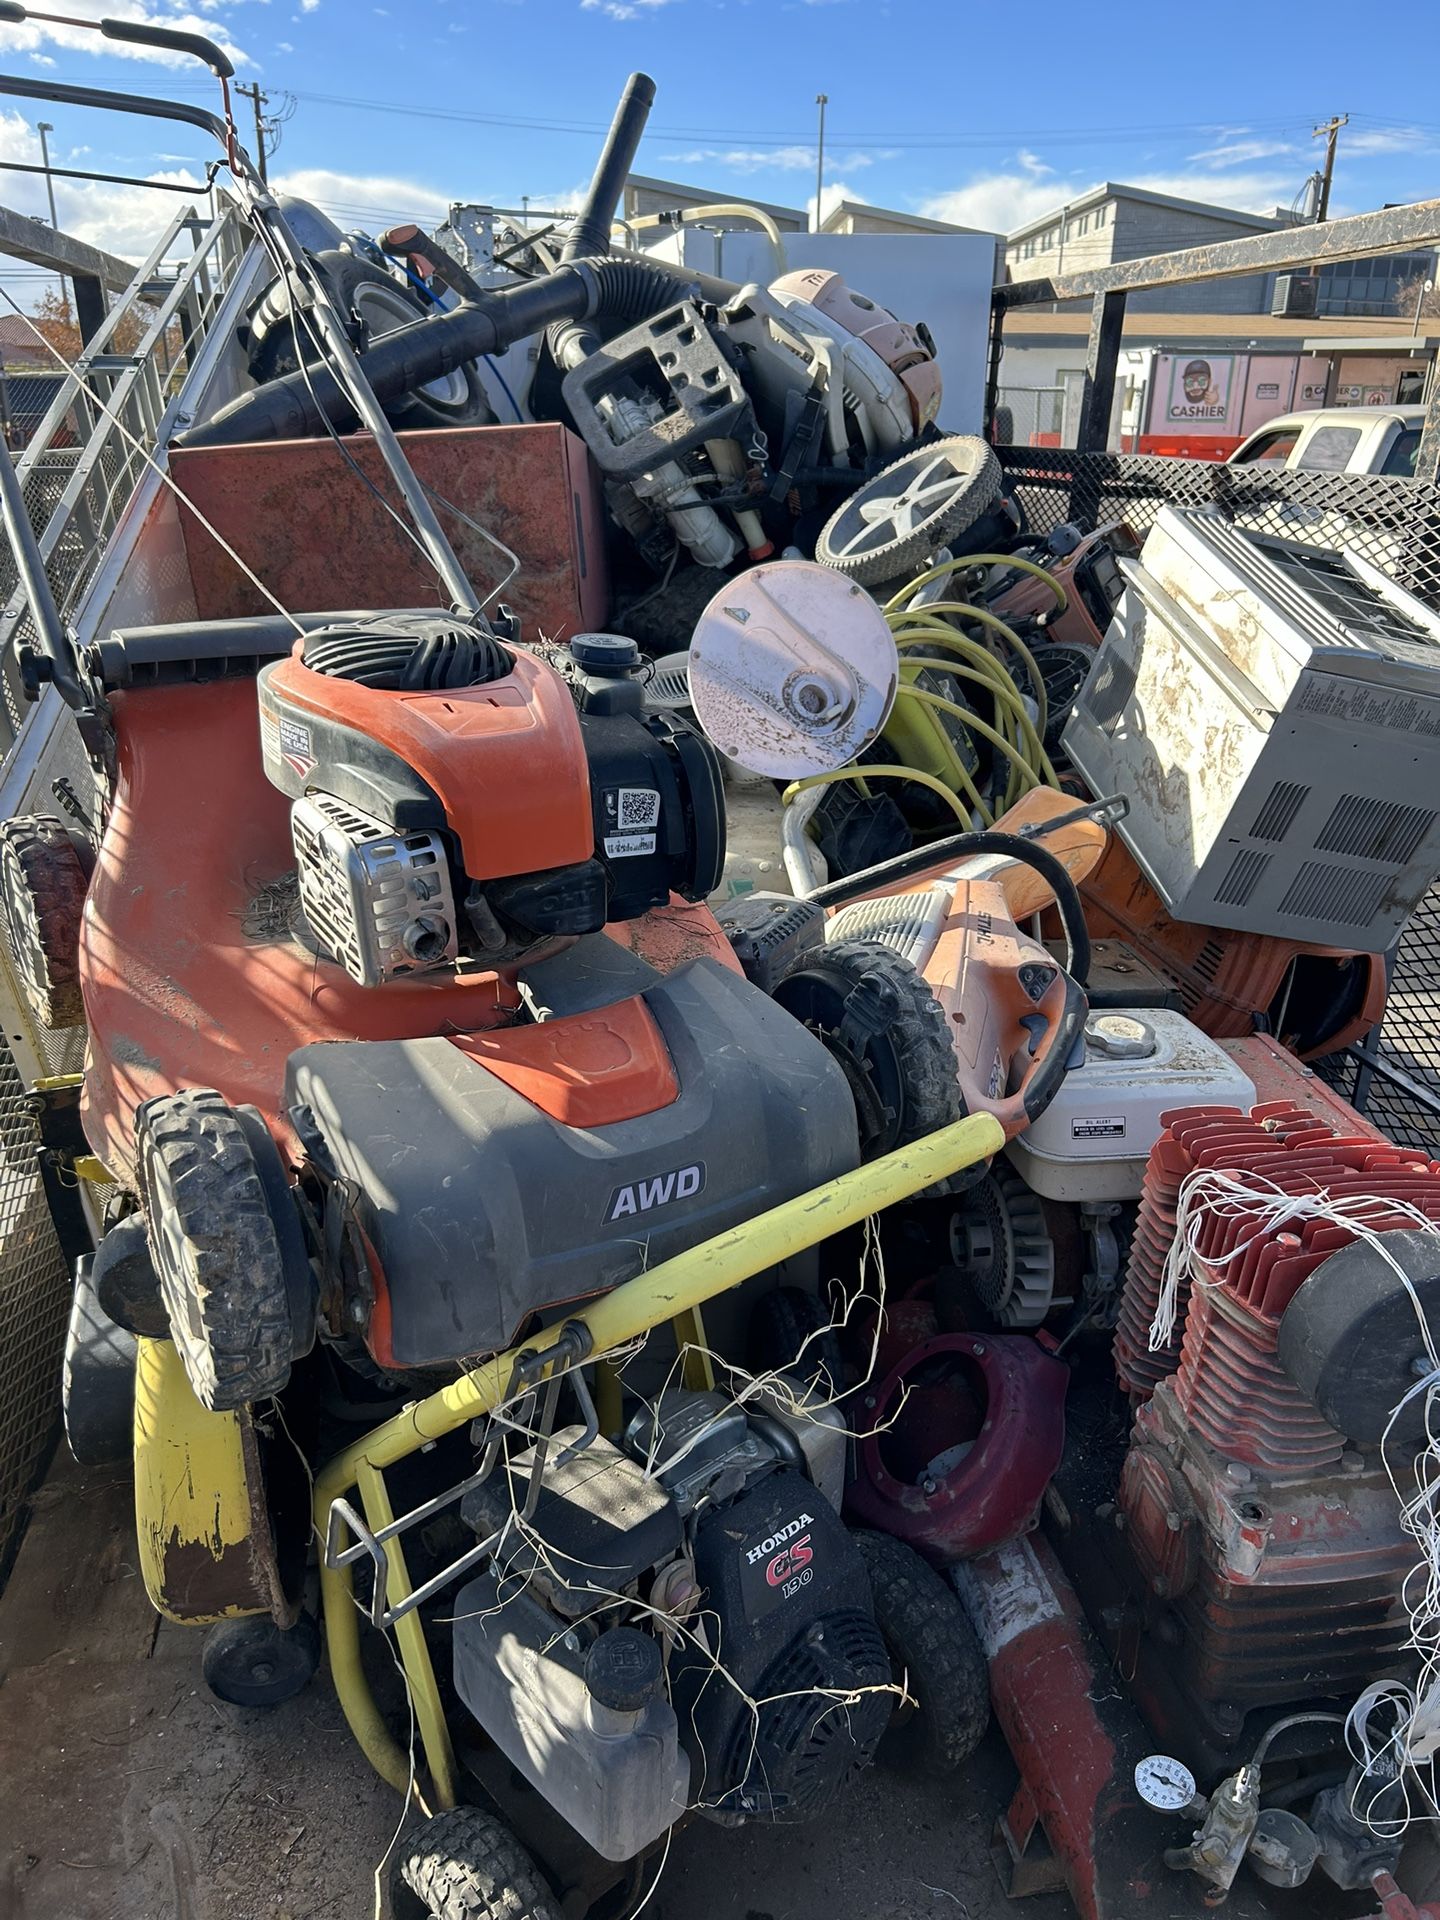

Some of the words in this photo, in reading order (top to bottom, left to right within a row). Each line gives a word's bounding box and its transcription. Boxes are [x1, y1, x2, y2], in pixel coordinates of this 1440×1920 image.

[1314, 386, 1350, 395] CAIER
[1170, 406, 1225, 417] CASHIER
[977, 911, 992, 944] STIHL
[611, 1166, 700, 1220] AWD
[745, 1513, 815, 1565] HONDA
[766, 1534, 814, 1587] GS
[782, 1567, 814, 1599] 190
